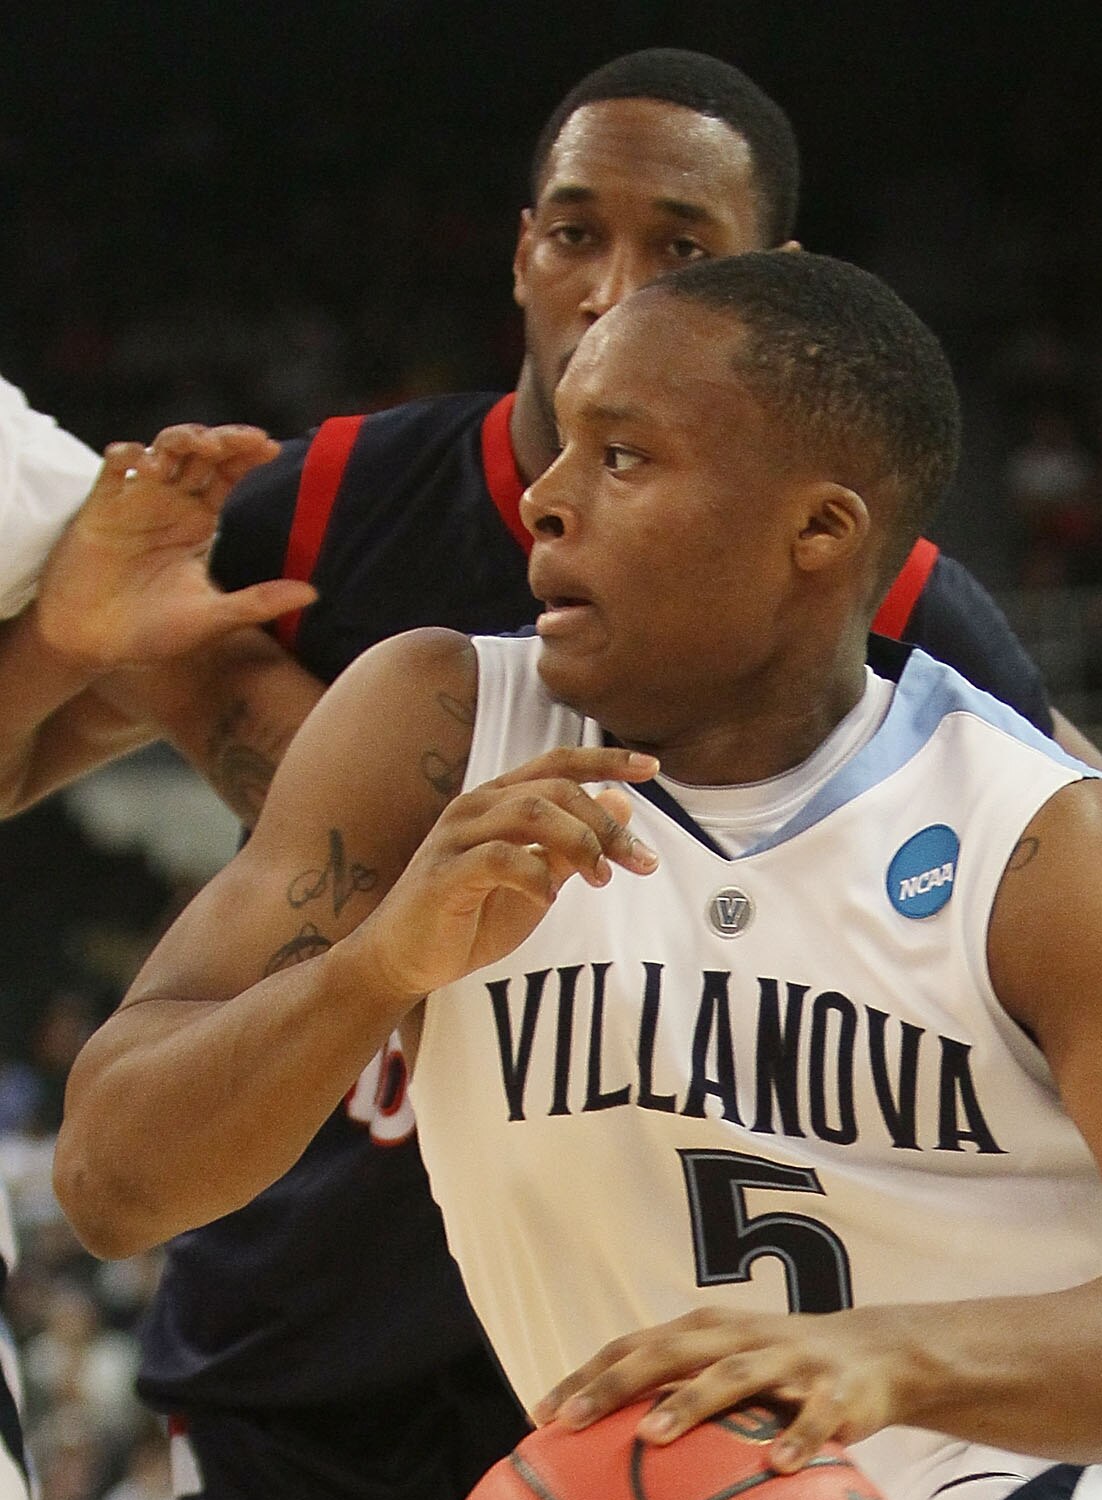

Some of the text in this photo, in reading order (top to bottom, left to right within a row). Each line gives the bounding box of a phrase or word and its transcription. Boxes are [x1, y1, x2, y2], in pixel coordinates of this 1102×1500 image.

[716, 896, 748, 929] V
[899, 862, 953, 901] NCAA
[486, 961, 1010, 1155] VILLANOVA
[677, 1147, 855, 1315] 5
